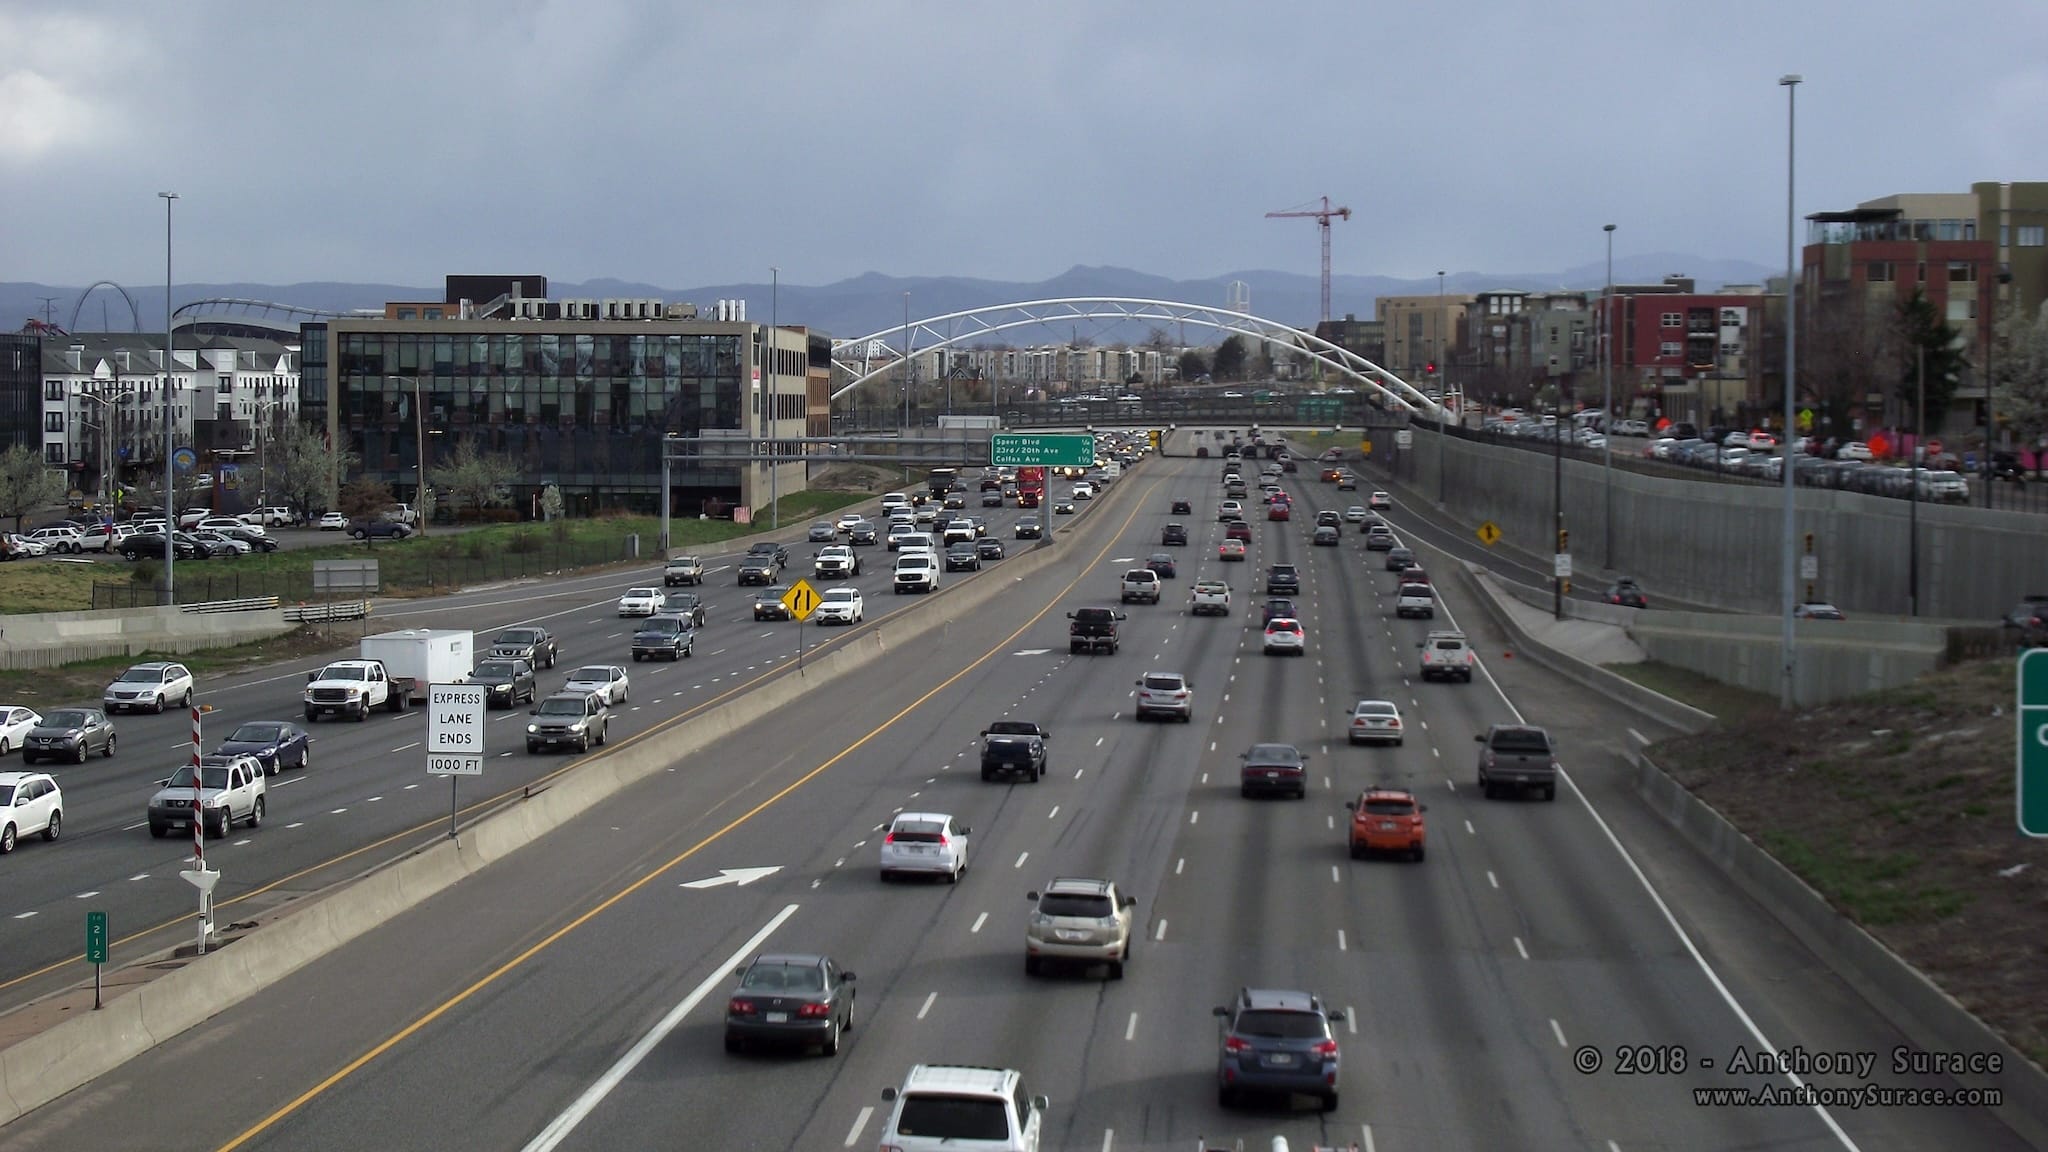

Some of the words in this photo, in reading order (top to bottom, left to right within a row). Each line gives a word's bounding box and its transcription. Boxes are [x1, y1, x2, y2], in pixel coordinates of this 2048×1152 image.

[996, 438, 1018, 446] Speer
[434, 693, 480, 704] EXPRESS
[440, 713, 472, 724] LANE
[439, 733, 472, 744] ENDS
[431, 759, 460, 770] 1000
[465, 760, 479, 771] FT
